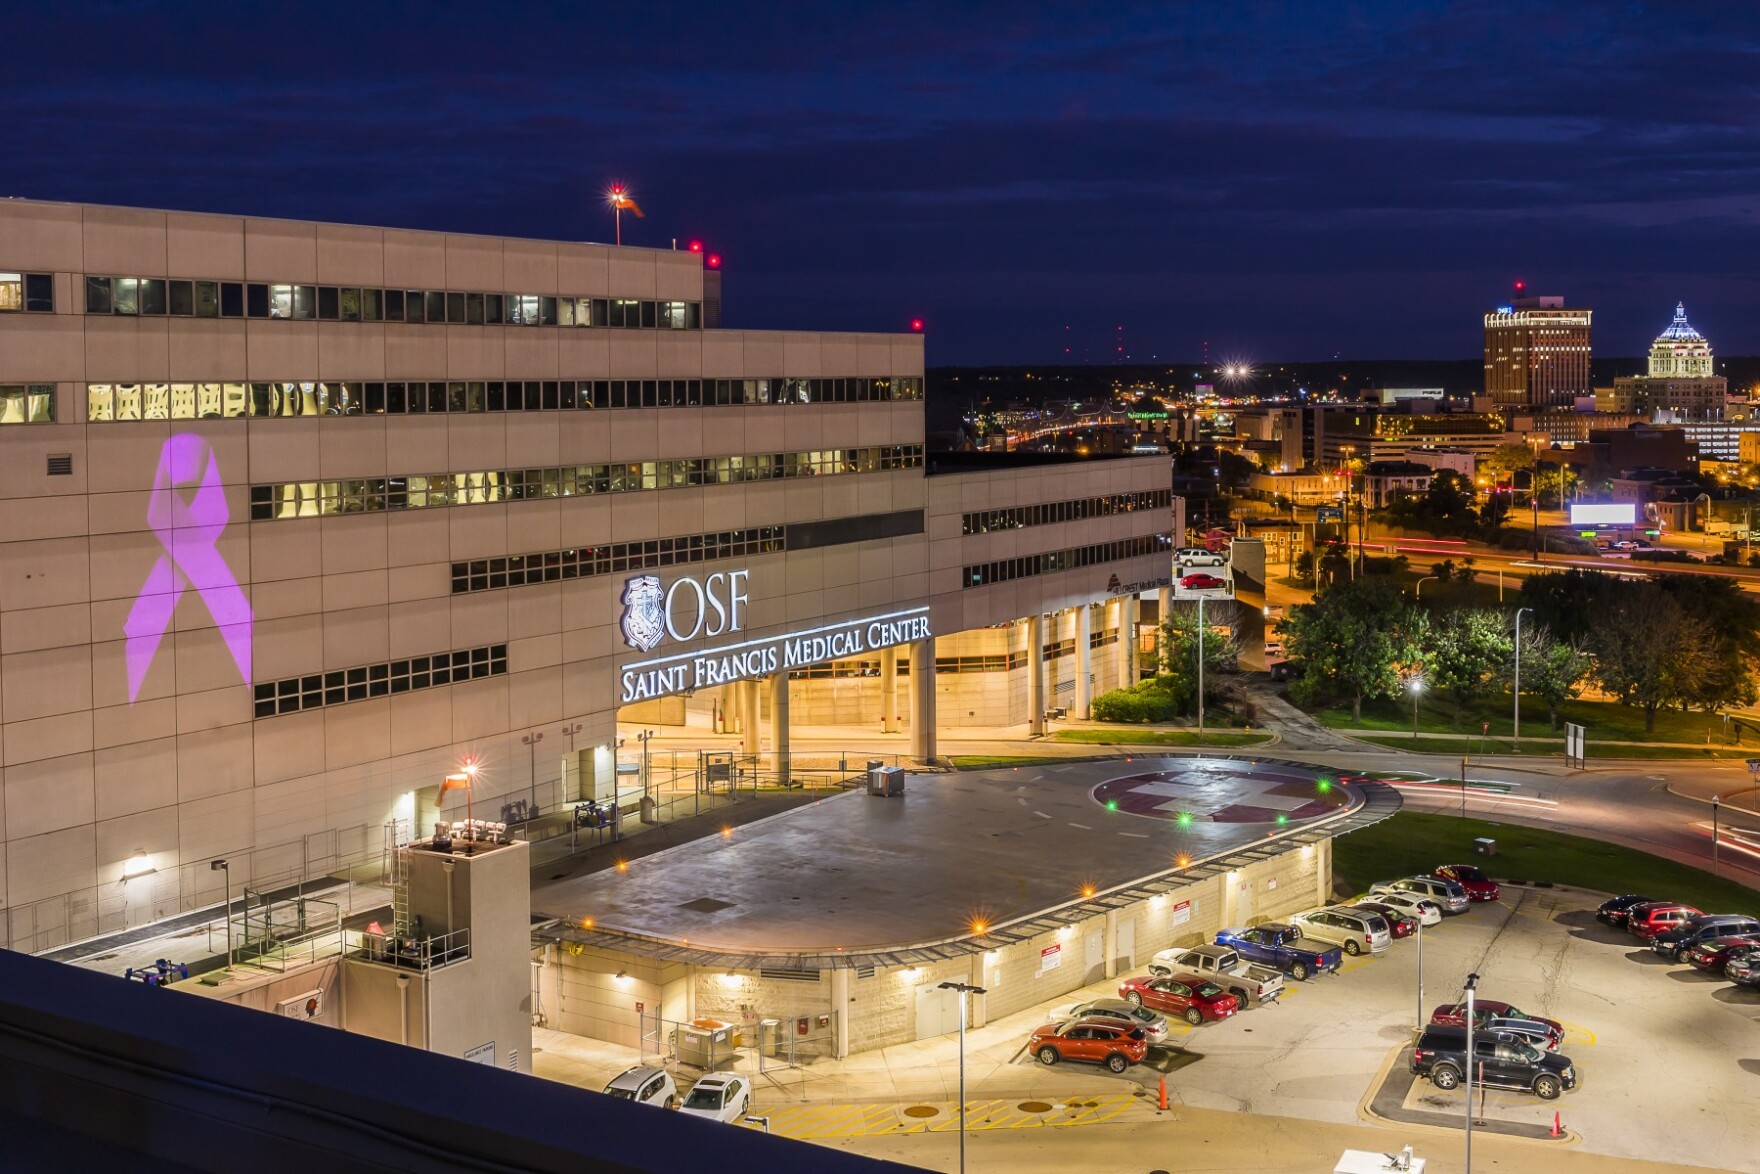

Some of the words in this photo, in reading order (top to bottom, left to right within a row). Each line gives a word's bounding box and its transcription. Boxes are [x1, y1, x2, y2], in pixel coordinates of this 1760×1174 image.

[665, 569, 749, 642] OSF
[622, 664, 687, 702] SAINT
[693, 645, 777, 687] FRANCIS
[784, 632, 864, 667] MEDICAL
[867, 615, 932, 648] CENTER
